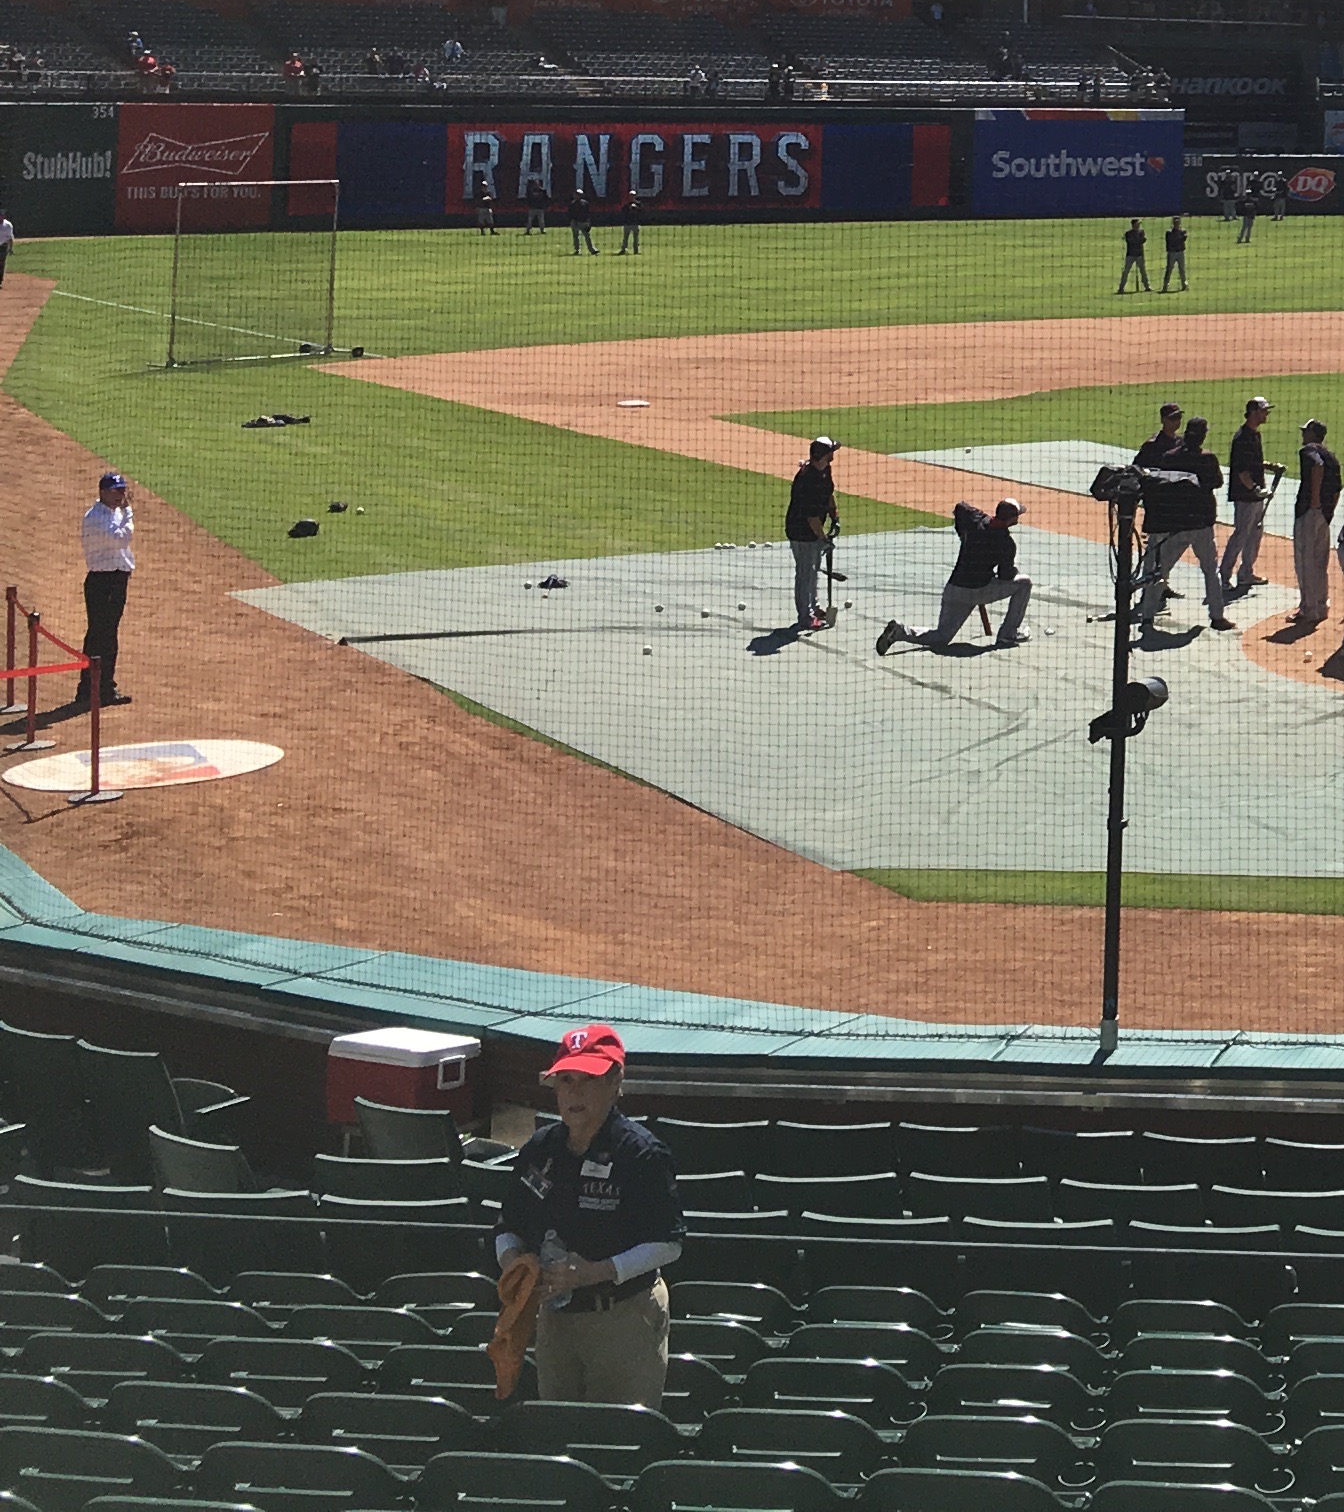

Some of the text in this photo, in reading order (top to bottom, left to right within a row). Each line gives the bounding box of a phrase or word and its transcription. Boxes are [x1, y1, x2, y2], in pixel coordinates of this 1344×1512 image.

[92, 107, 114, 118] 354
[135, 141, 255, 164] Budweiser
[991, 148, 1147, 178] Southwest
[22, 149, 112, 180] StubHub!
[462, 131, 811, 200] RANGERS
[127, 186, 156, 200] THIS
[203, 186, 228, 199] FOR
[232, 186, 261, 199] YOU.
[1296, 176, 1329, 194] DQ
[568, 1030, 589, 1051] T
